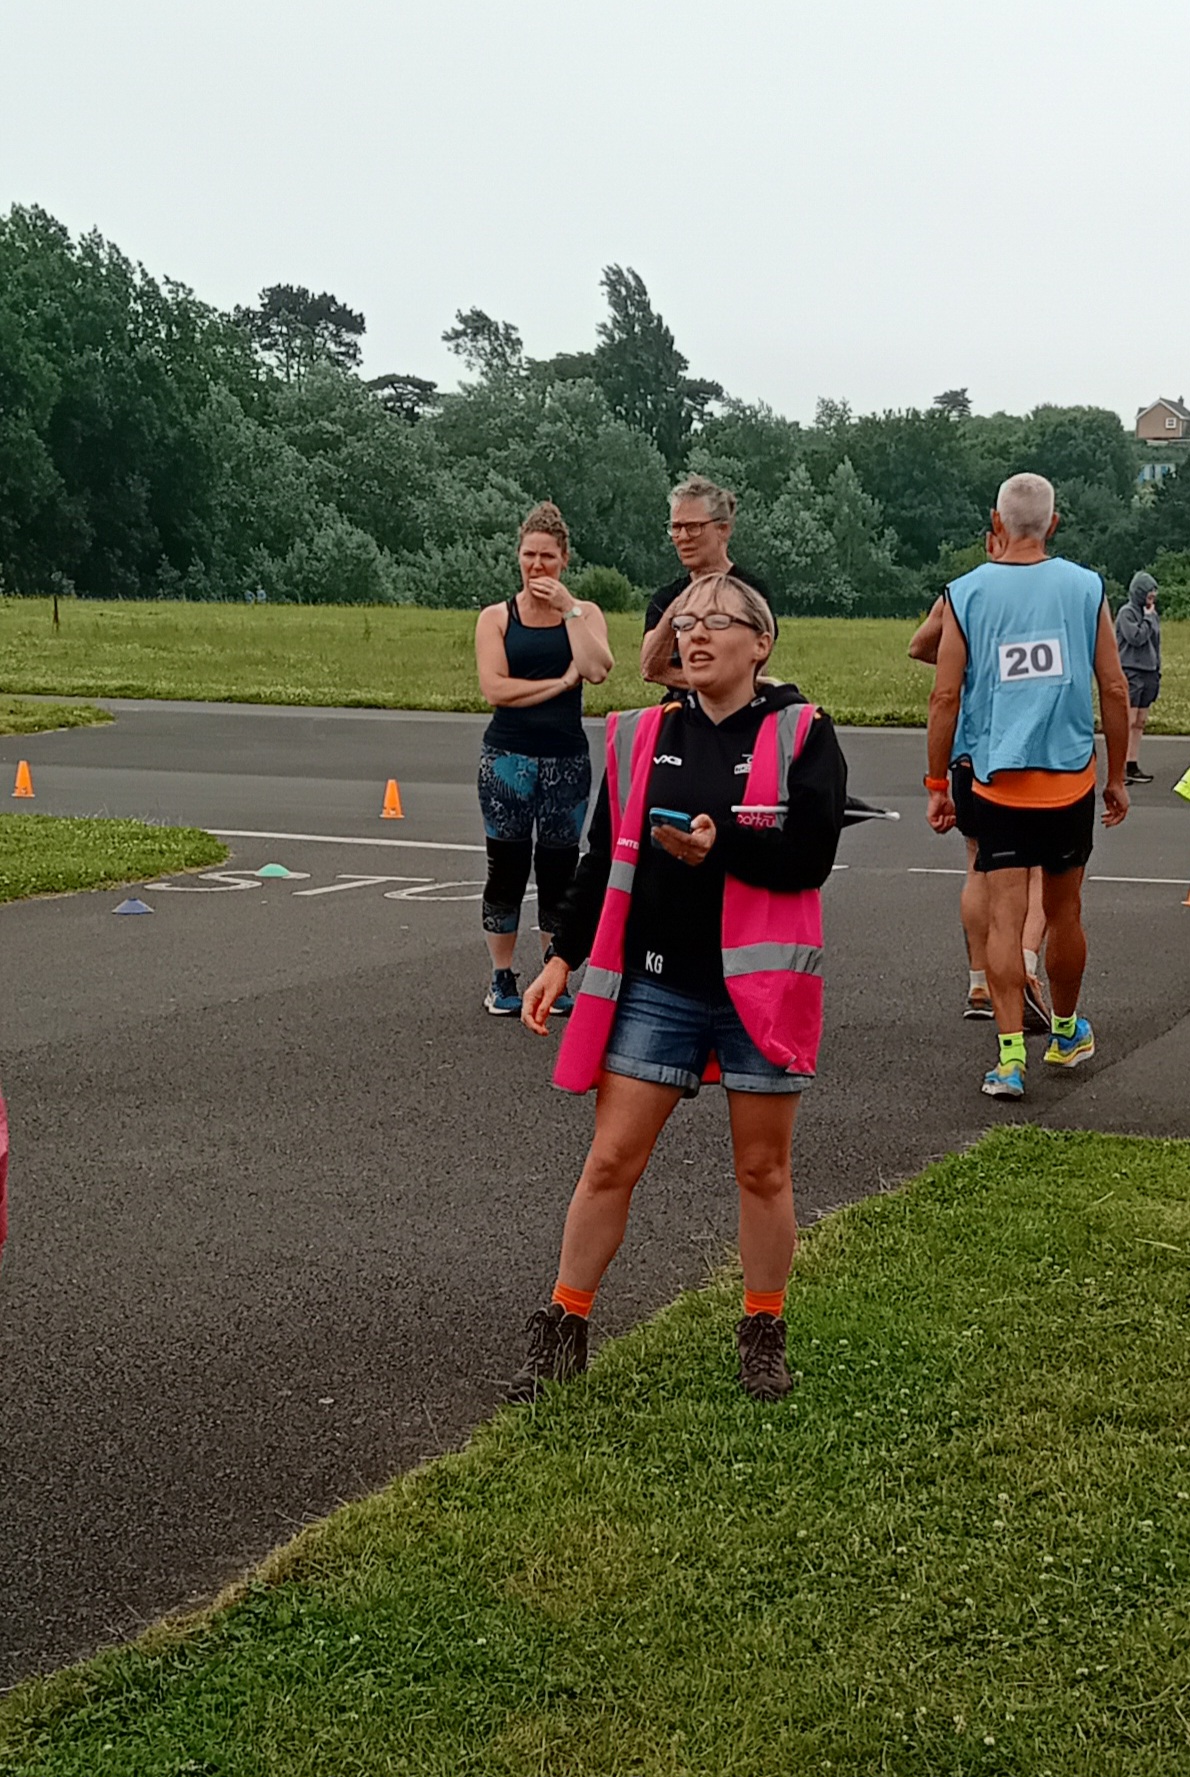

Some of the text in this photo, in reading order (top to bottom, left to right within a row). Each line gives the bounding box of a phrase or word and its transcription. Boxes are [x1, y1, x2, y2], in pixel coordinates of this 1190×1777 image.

[1005, 643, 1053, 677] 20
[143, 870, 539, 901] STO
[645, 950, 664, 975] KG
